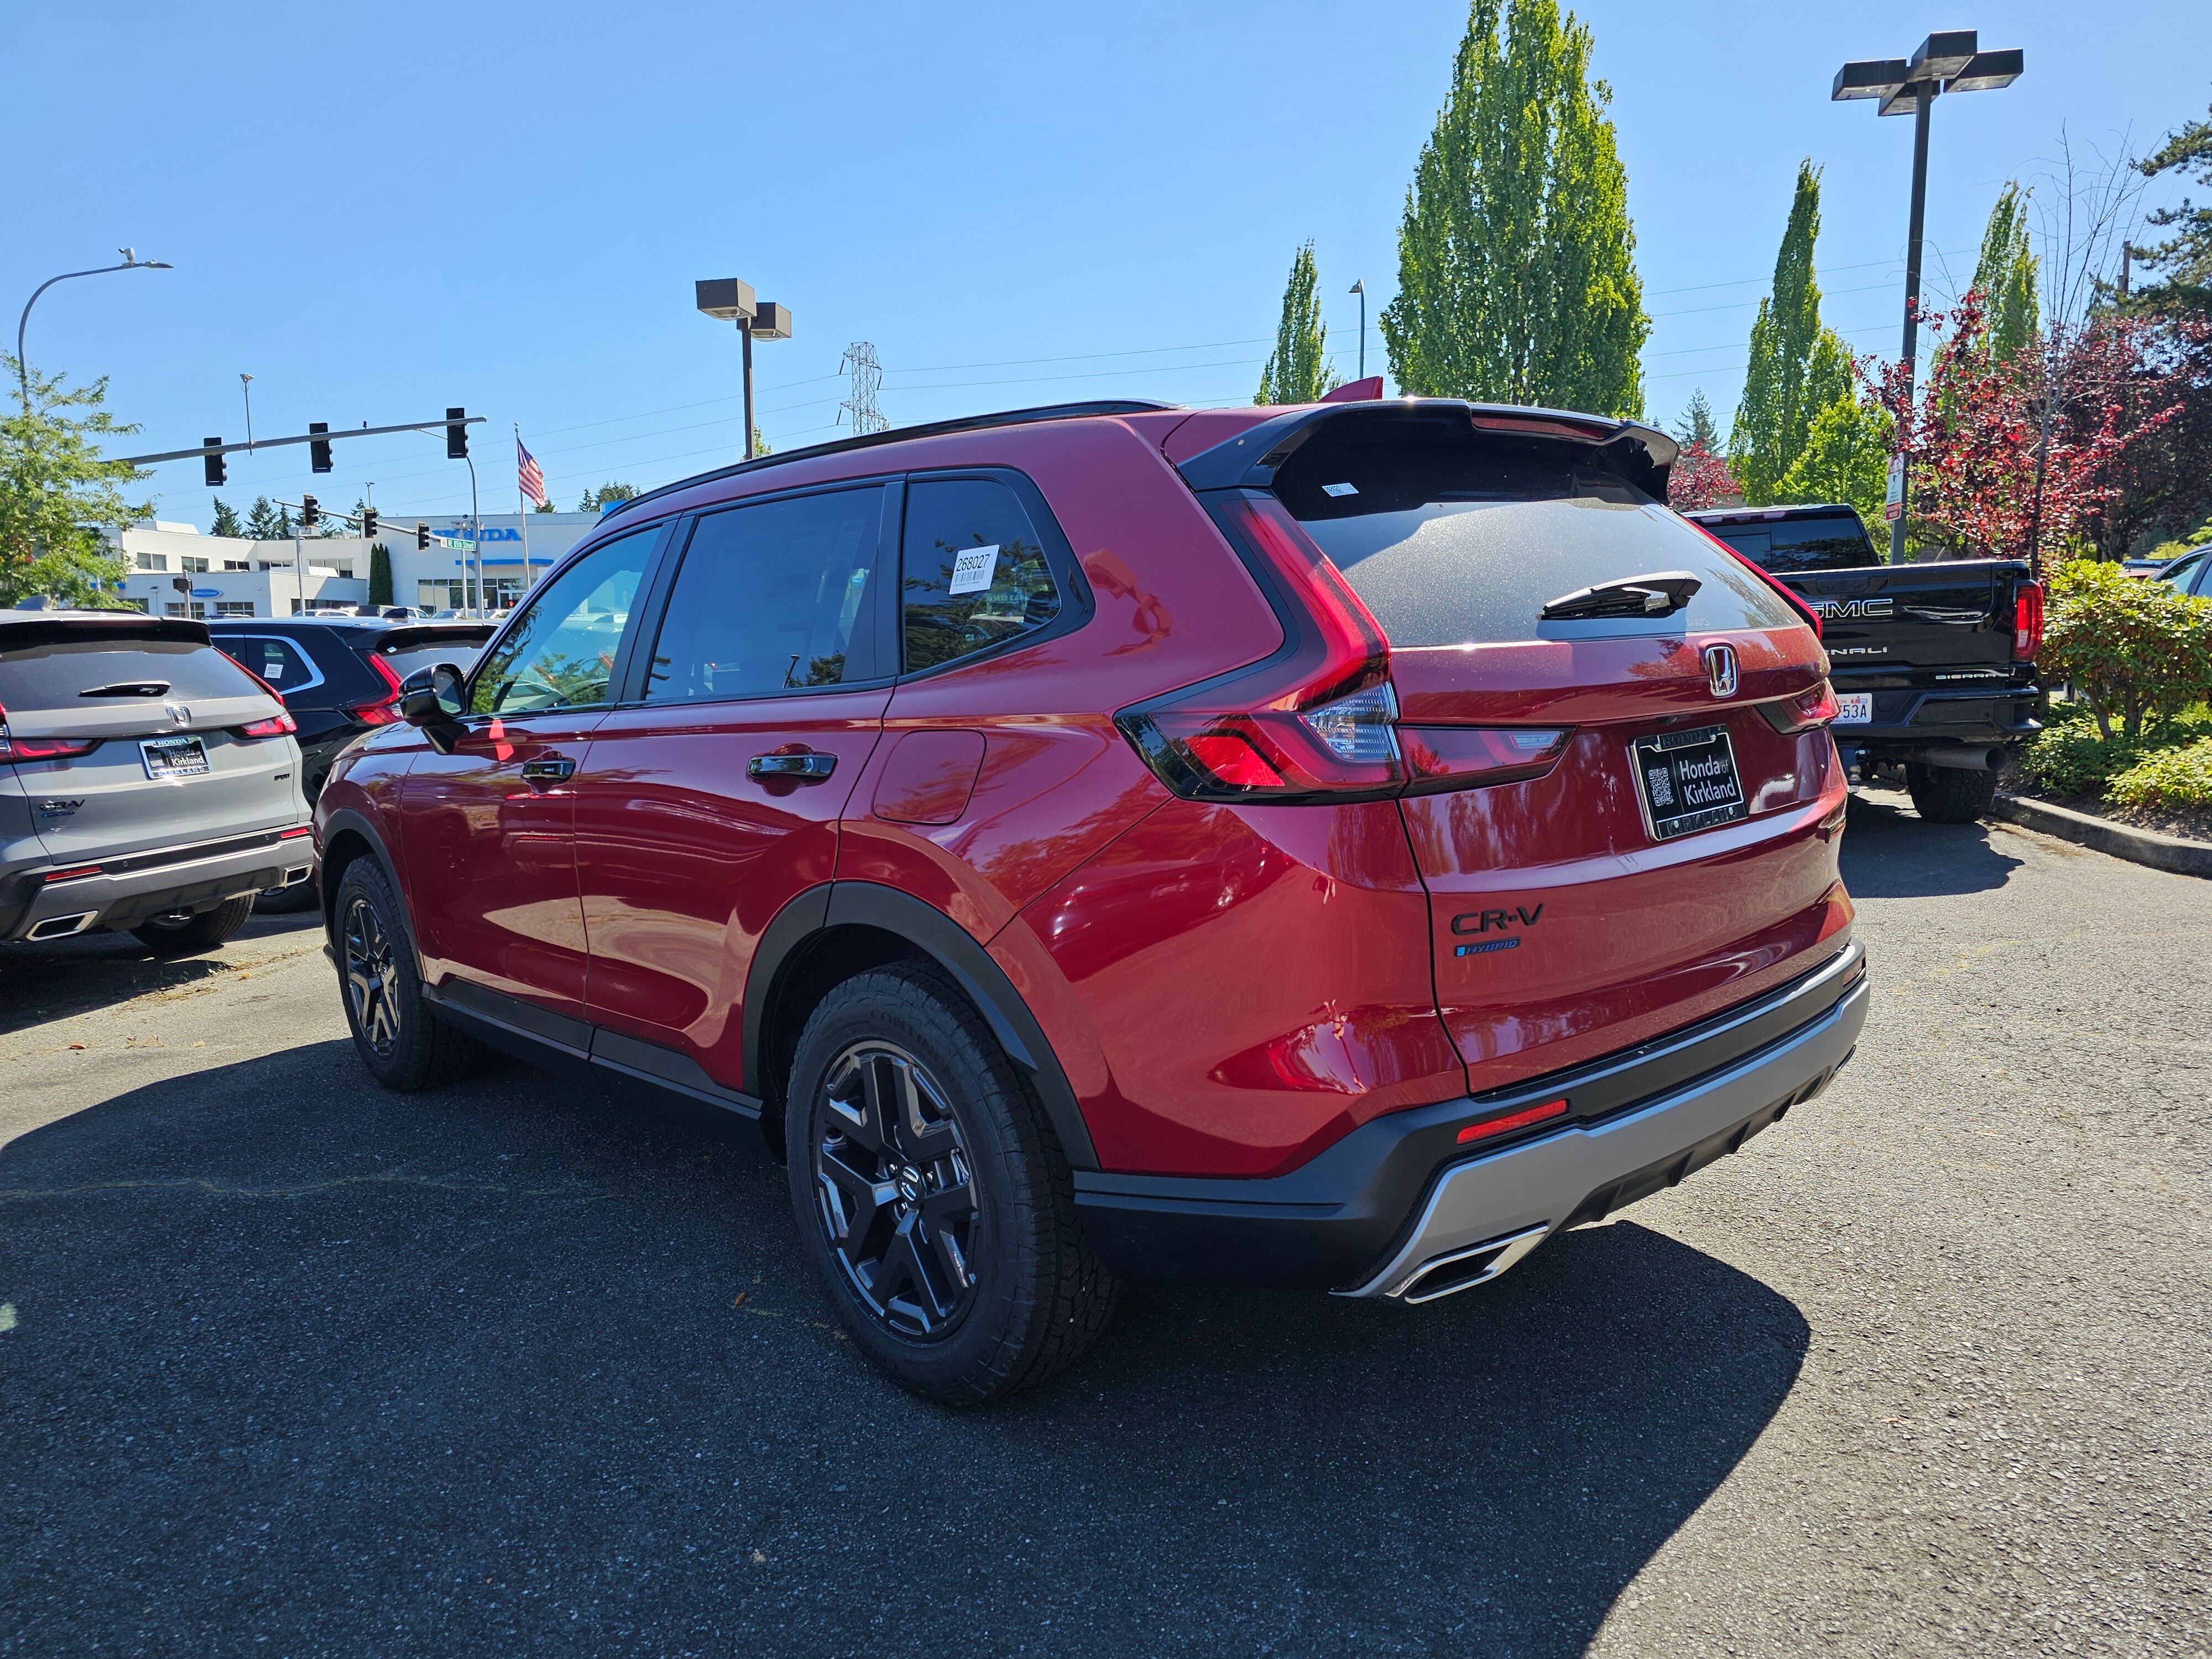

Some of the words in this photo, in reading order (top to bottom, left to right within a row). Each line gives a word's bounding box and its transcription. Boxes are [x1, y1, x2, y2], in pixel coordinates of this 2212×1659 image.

[453, 540, 463, 548] 85th
[956, 554, 990, 572] 268027
[1825, 646, 1887, 655] NALI
[1662, 731, 1705, 747] HONDA
[169, 748, 195, 758] Honda
[171, 755, 205, 767] Kirkland
[1679, 755, 1721, 780] Honda
[1721, 760, 1729, 773] of
[1684, 776, 1736, 805] Kirkland
[1451, 902, 1545, 935] CR-V
[1466, 940, 1517, 954] HYBRID
